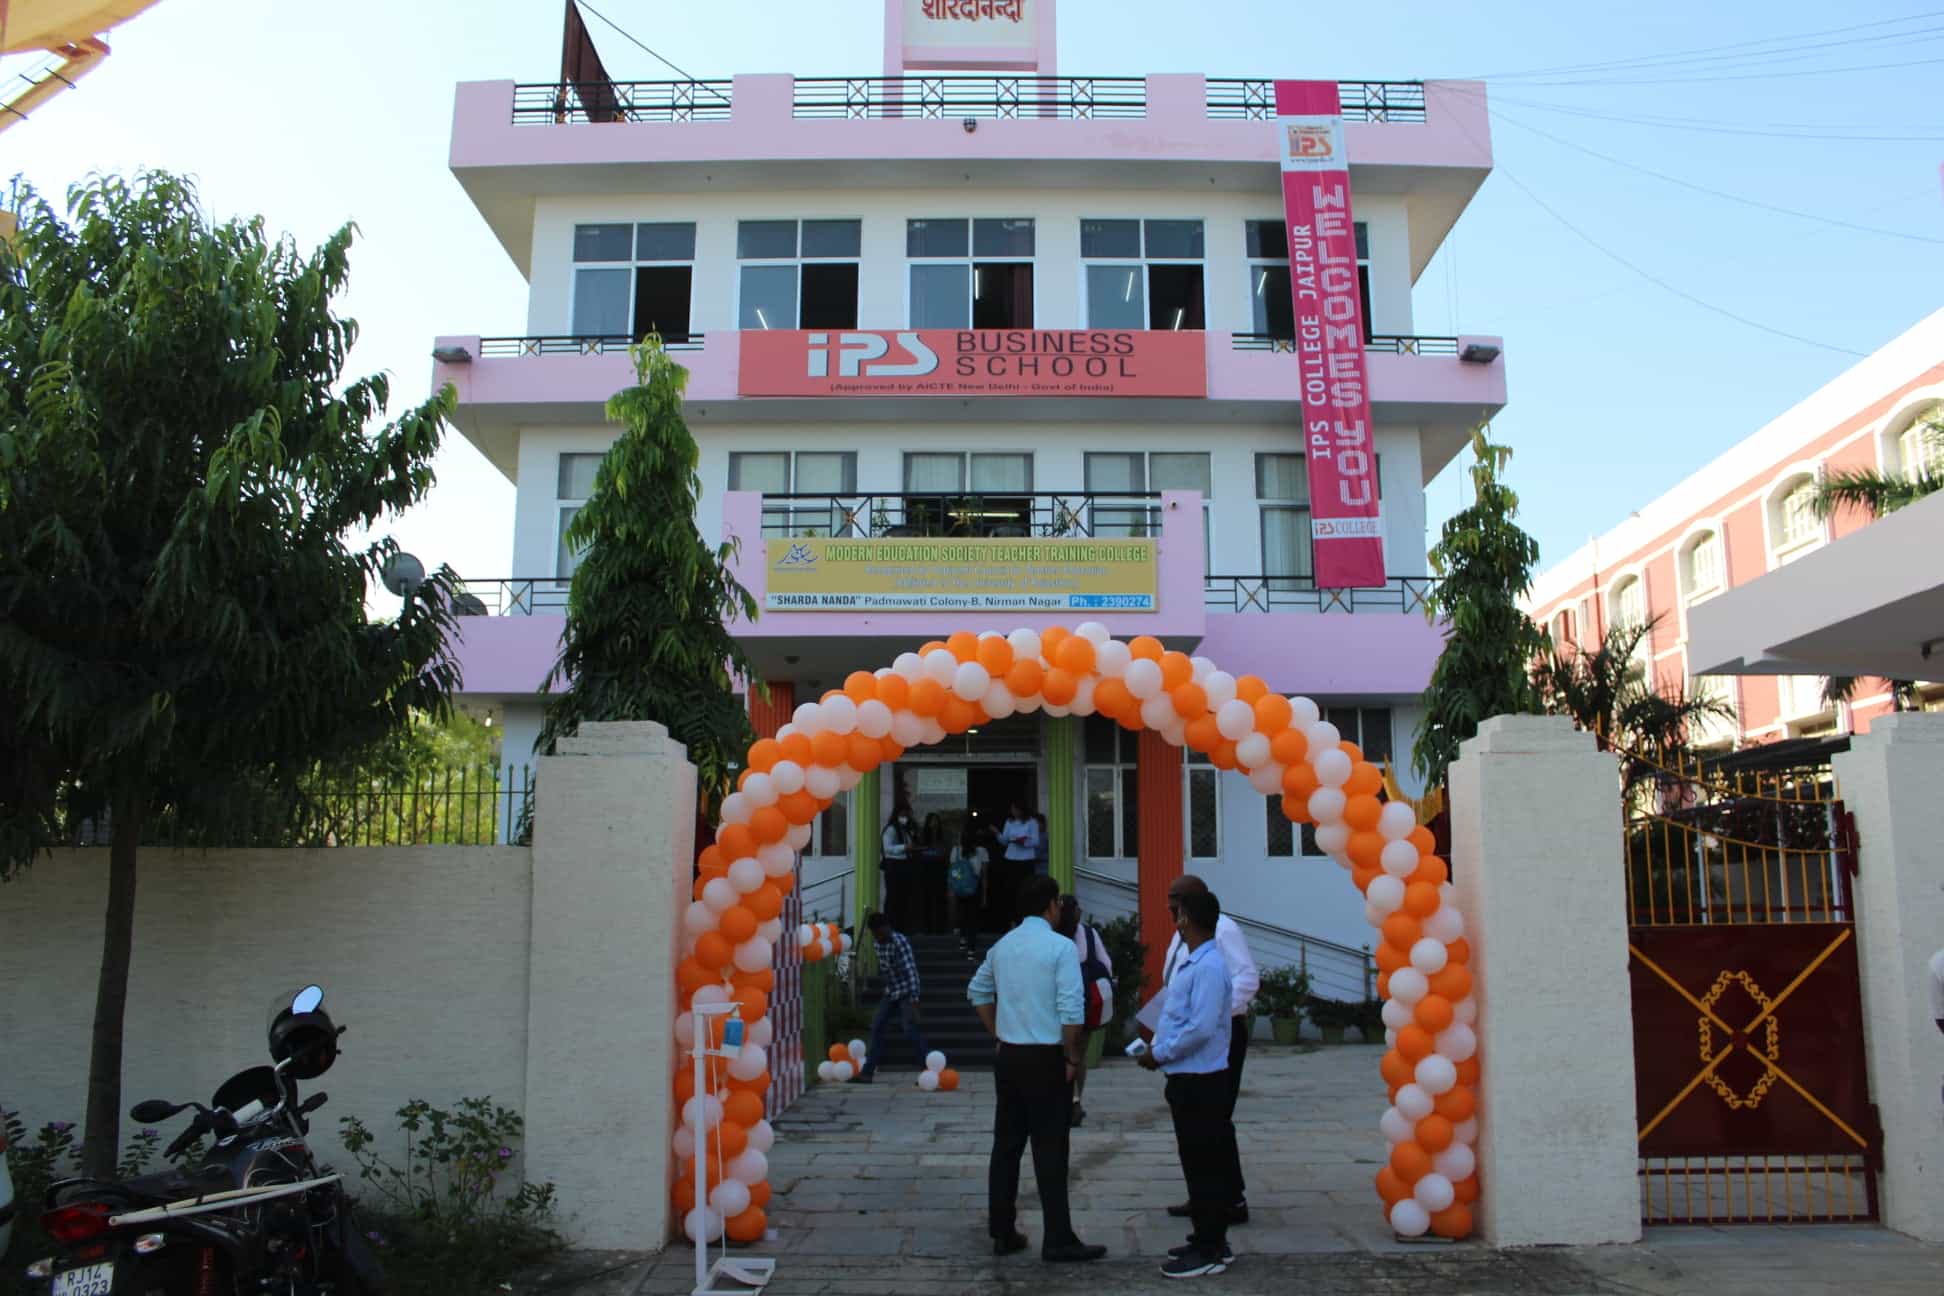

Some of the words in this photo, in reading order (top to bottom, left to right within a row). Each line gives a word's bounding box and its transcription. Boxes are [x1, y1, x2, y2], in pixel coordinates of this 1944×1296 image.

[1293, 224, 1317, 299] JAIPUR
[1312, 184, 1363, 408] WELCOMES
[956, 332, 1134, 354] BUSINESS
[1301, 315, 1327, 406] COLLEGE
[956, 356, 1137, 377] SCHOOL
[1310, 420, 1331, 459] IPS
[1334, 420, 1371, 506] YOU
[825, 545, 872, 561] MODERN
[876, 545, 938, 561] EDUCATION
[942, 545, 988, 561] SOCIETY
[992, 545, 1041, 561] TEACHER
[1045, 545, 1096, 561] TRAINING
[1099, 545, 1148, 561] COLLEGE
[864, 596, 926, 606] Padmawati
[985, 597, 1025, 606] Nirman
[1029, 597, 1061, 608] Nagar
